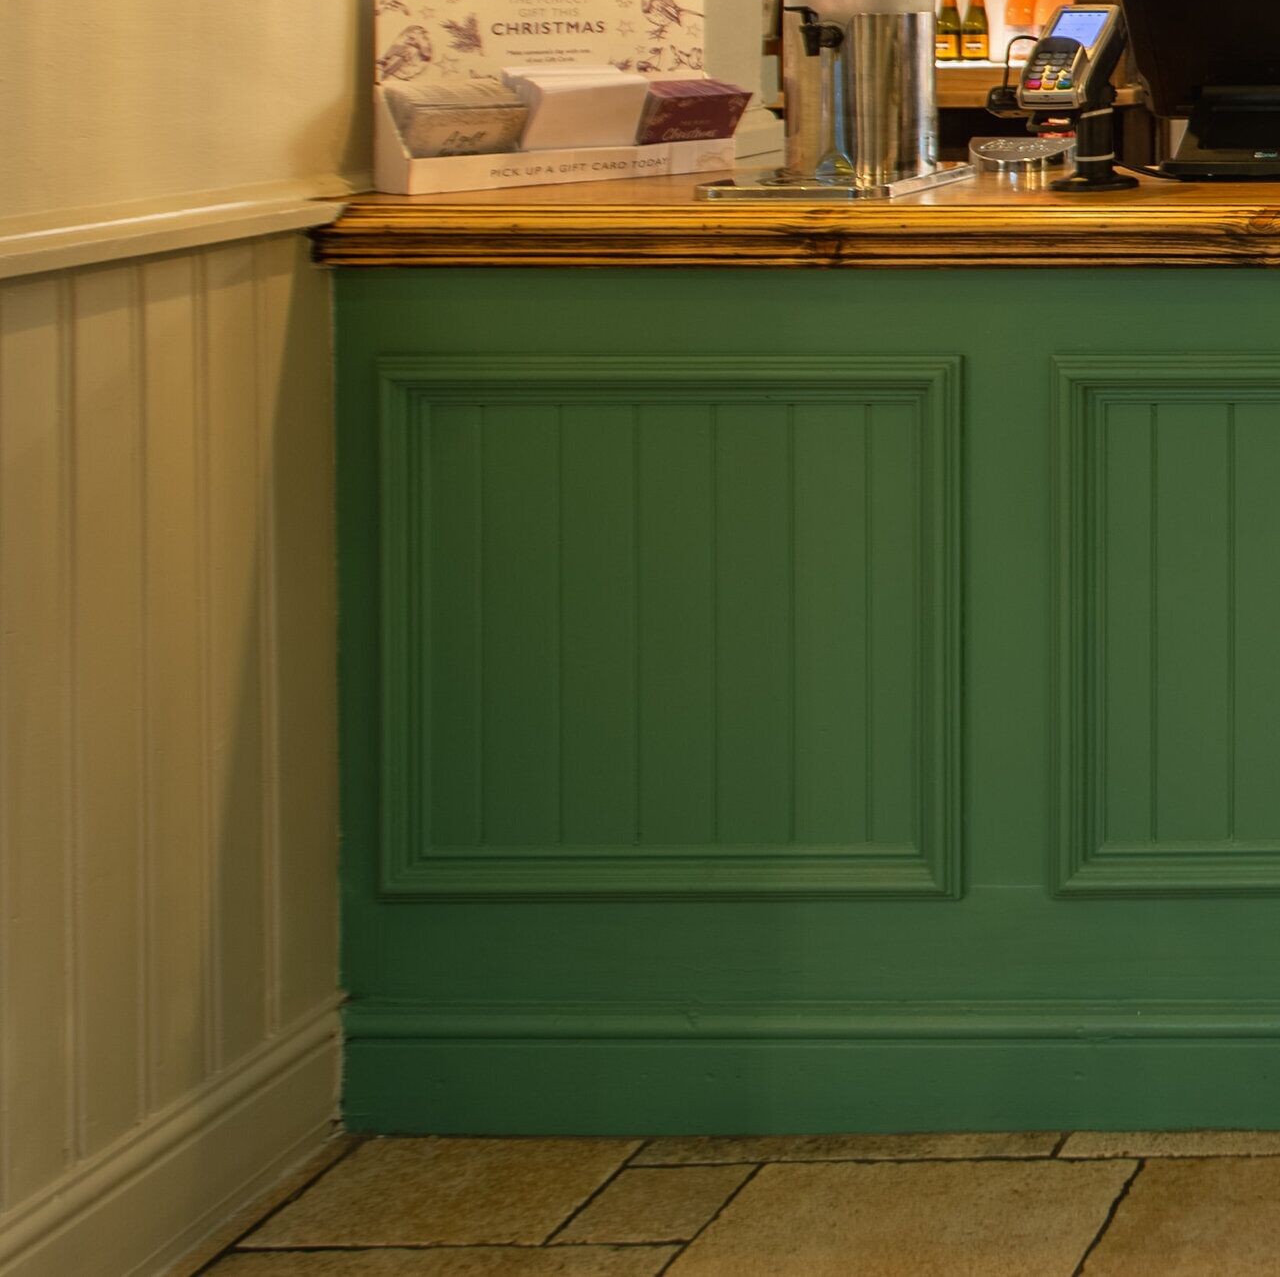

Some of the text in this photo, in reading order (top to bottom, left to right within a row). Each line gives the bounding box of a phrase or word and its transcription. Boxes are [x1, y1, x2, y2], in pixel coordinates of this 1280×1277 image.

[518, 7, 580, 17] GIFT THIS
[491, 21, 606, 36] CHRISTMAS
[490, 156, 669, 178] PICK UP A GIFT CARD TODAY
